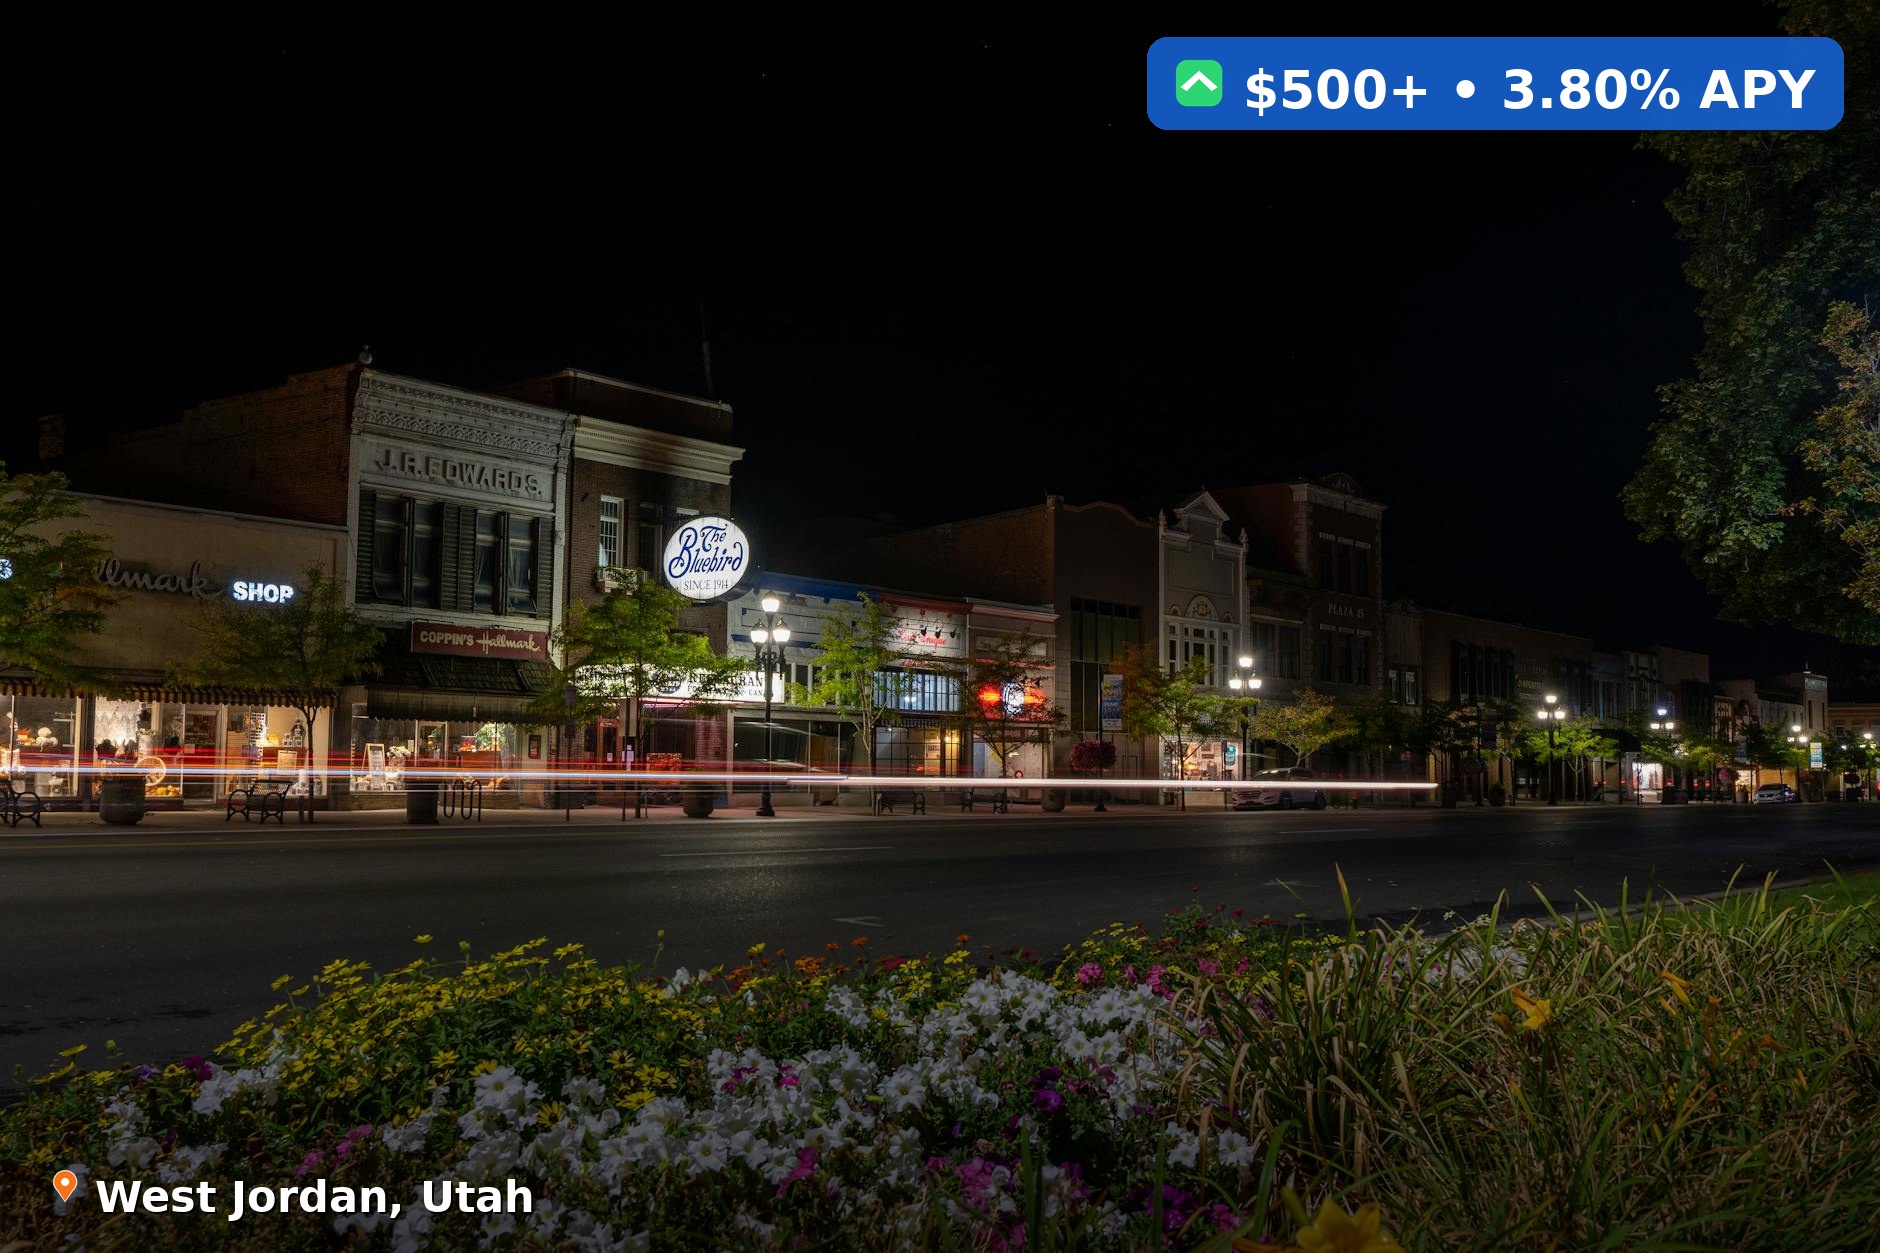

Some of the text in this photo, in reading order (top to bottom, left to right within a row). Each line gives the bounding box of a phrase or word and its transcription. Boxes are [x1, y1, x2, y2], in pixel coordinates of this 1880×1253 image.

[700, 523, 728, 552] The
[669, 527, 743, 578] Bluebird
[92, 558, 294, 604] llmark SHOP
[683, 579, 729, 591] SINCE 1914
[419, 630, 475, 646] COPPIN'S
